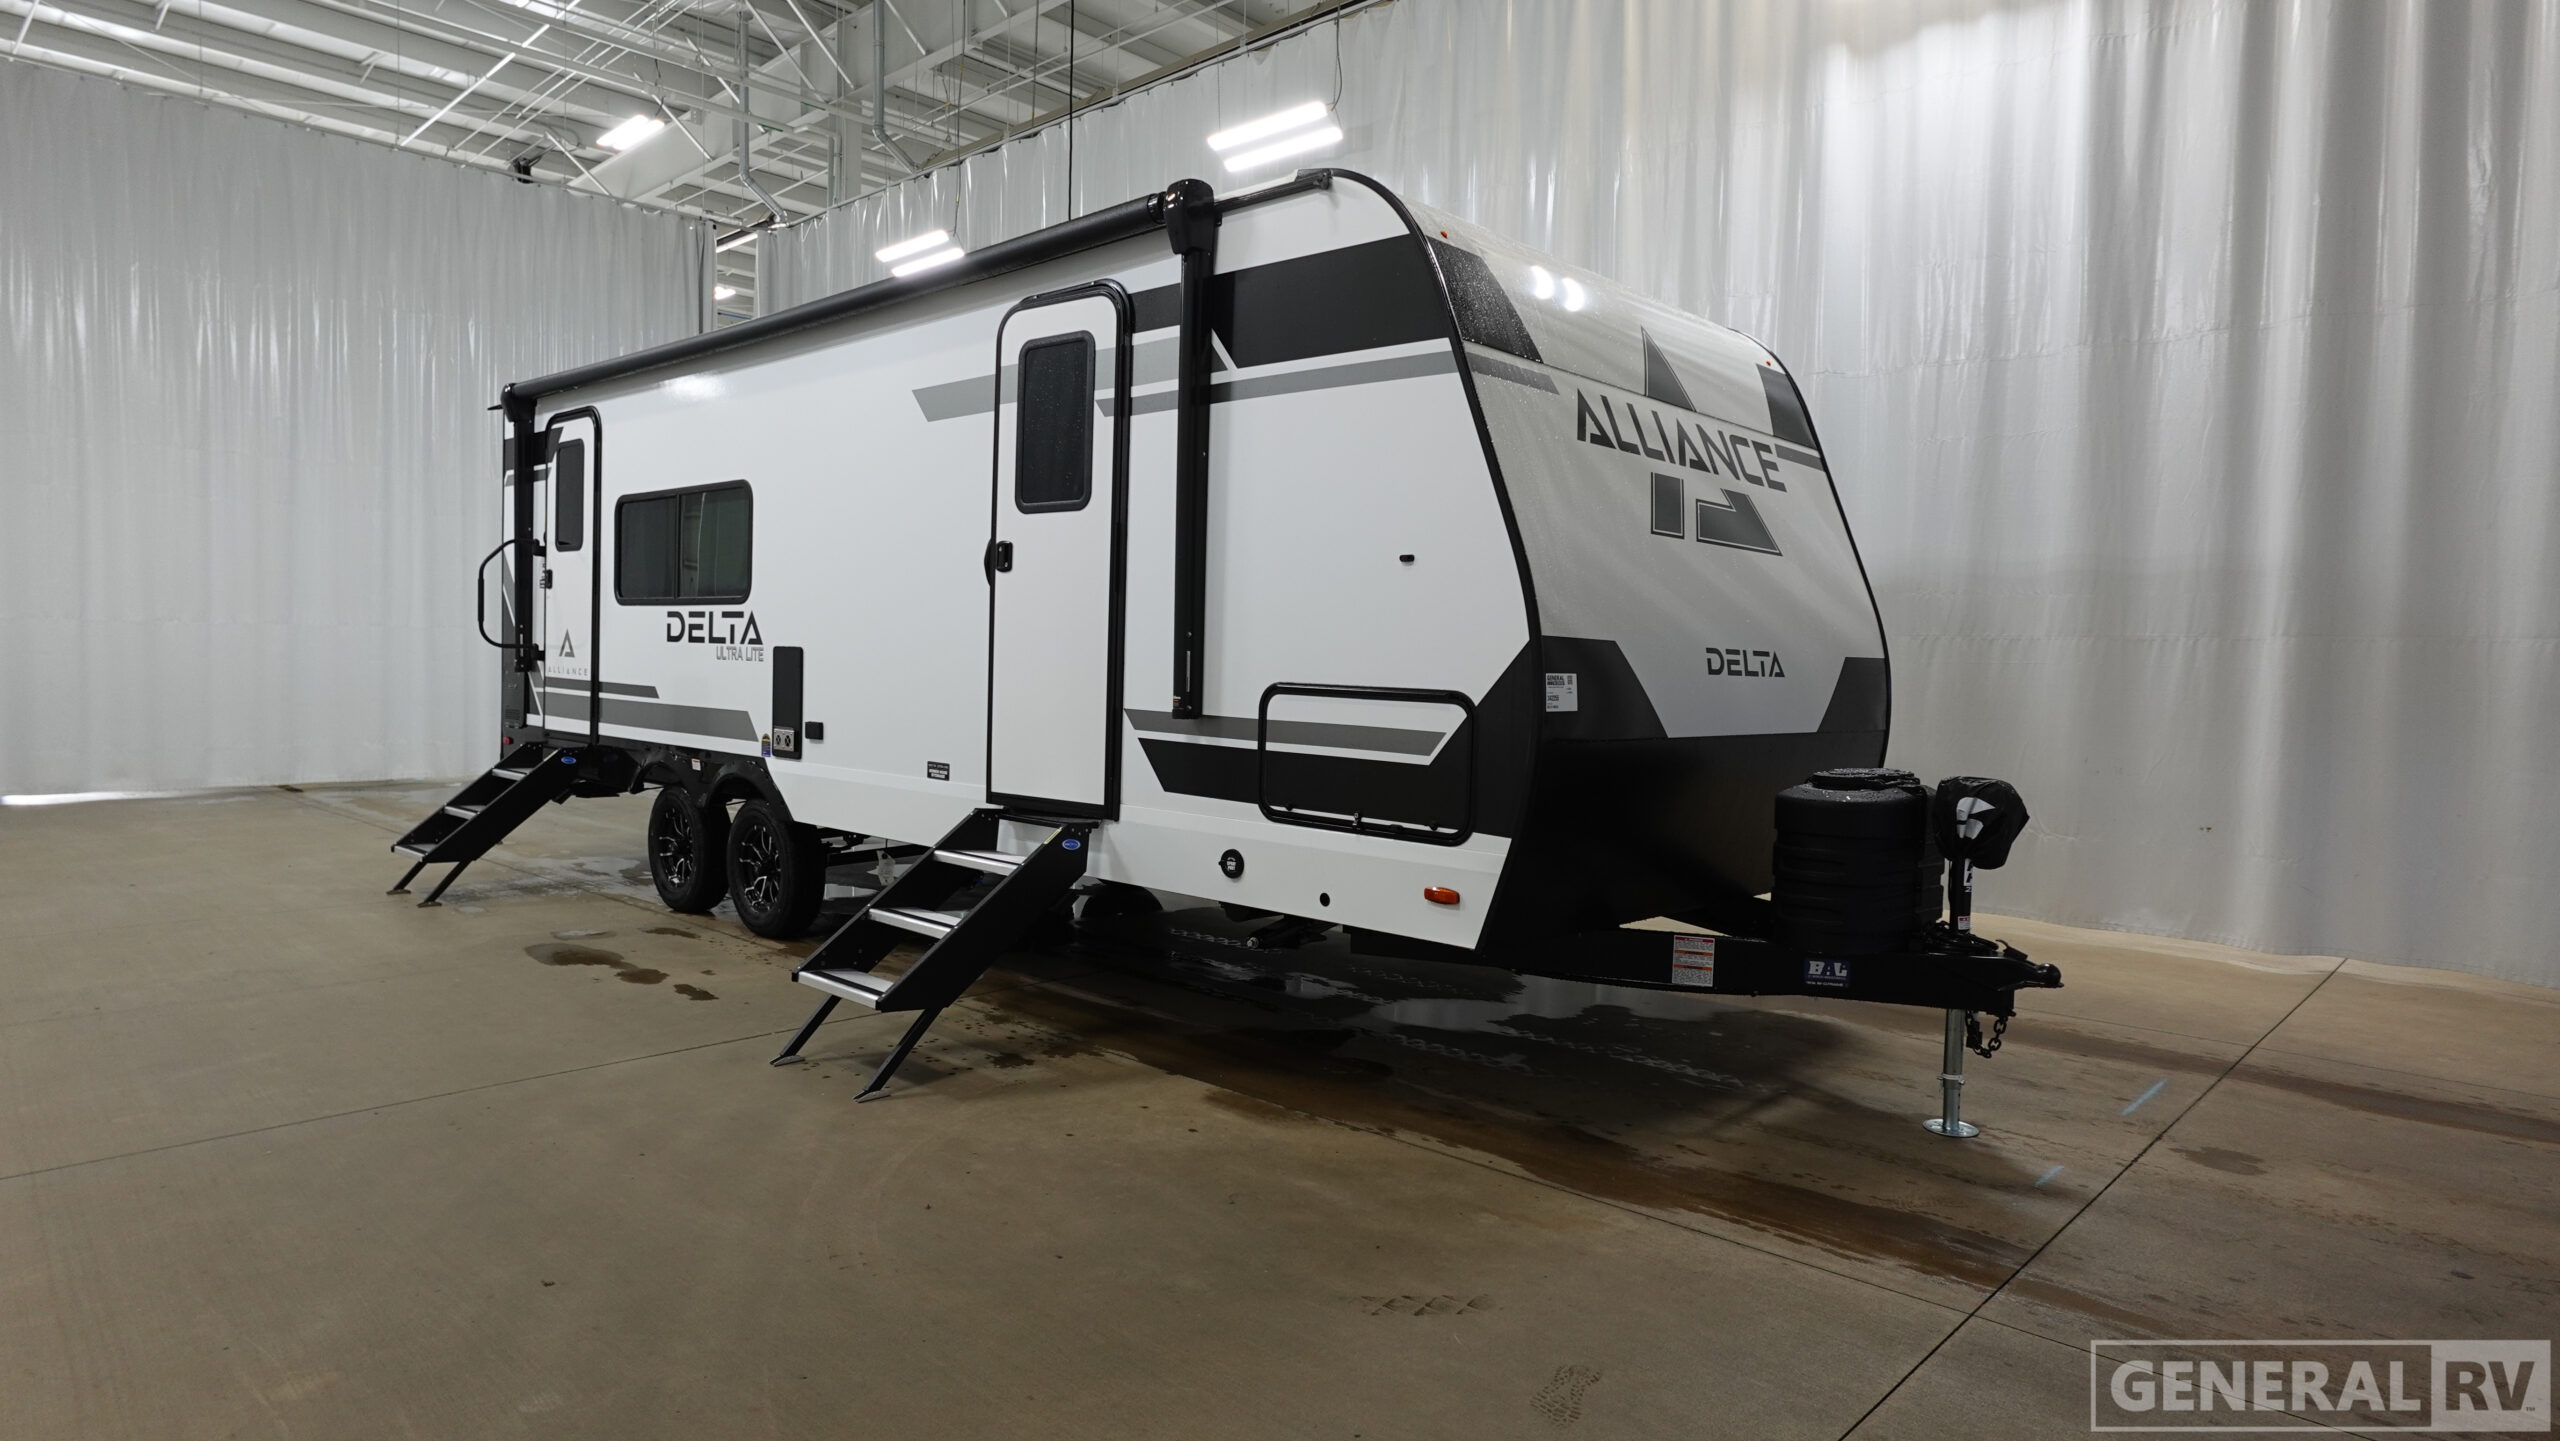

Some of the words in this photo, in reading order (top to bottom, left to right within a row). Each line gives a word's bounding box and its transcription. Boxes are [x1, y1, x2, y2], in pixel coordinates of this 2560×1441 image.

[1577, 388, 1787, 493] ALLIANCE
[667, 611, 763, 645] DELTA
[716, 646, 744, 661] ULTRA
[745, 646, 764, 662] LITE
[1706, 647, 1785, 678] DELTA
[548, 665, 588, 676] ALLIANCE
